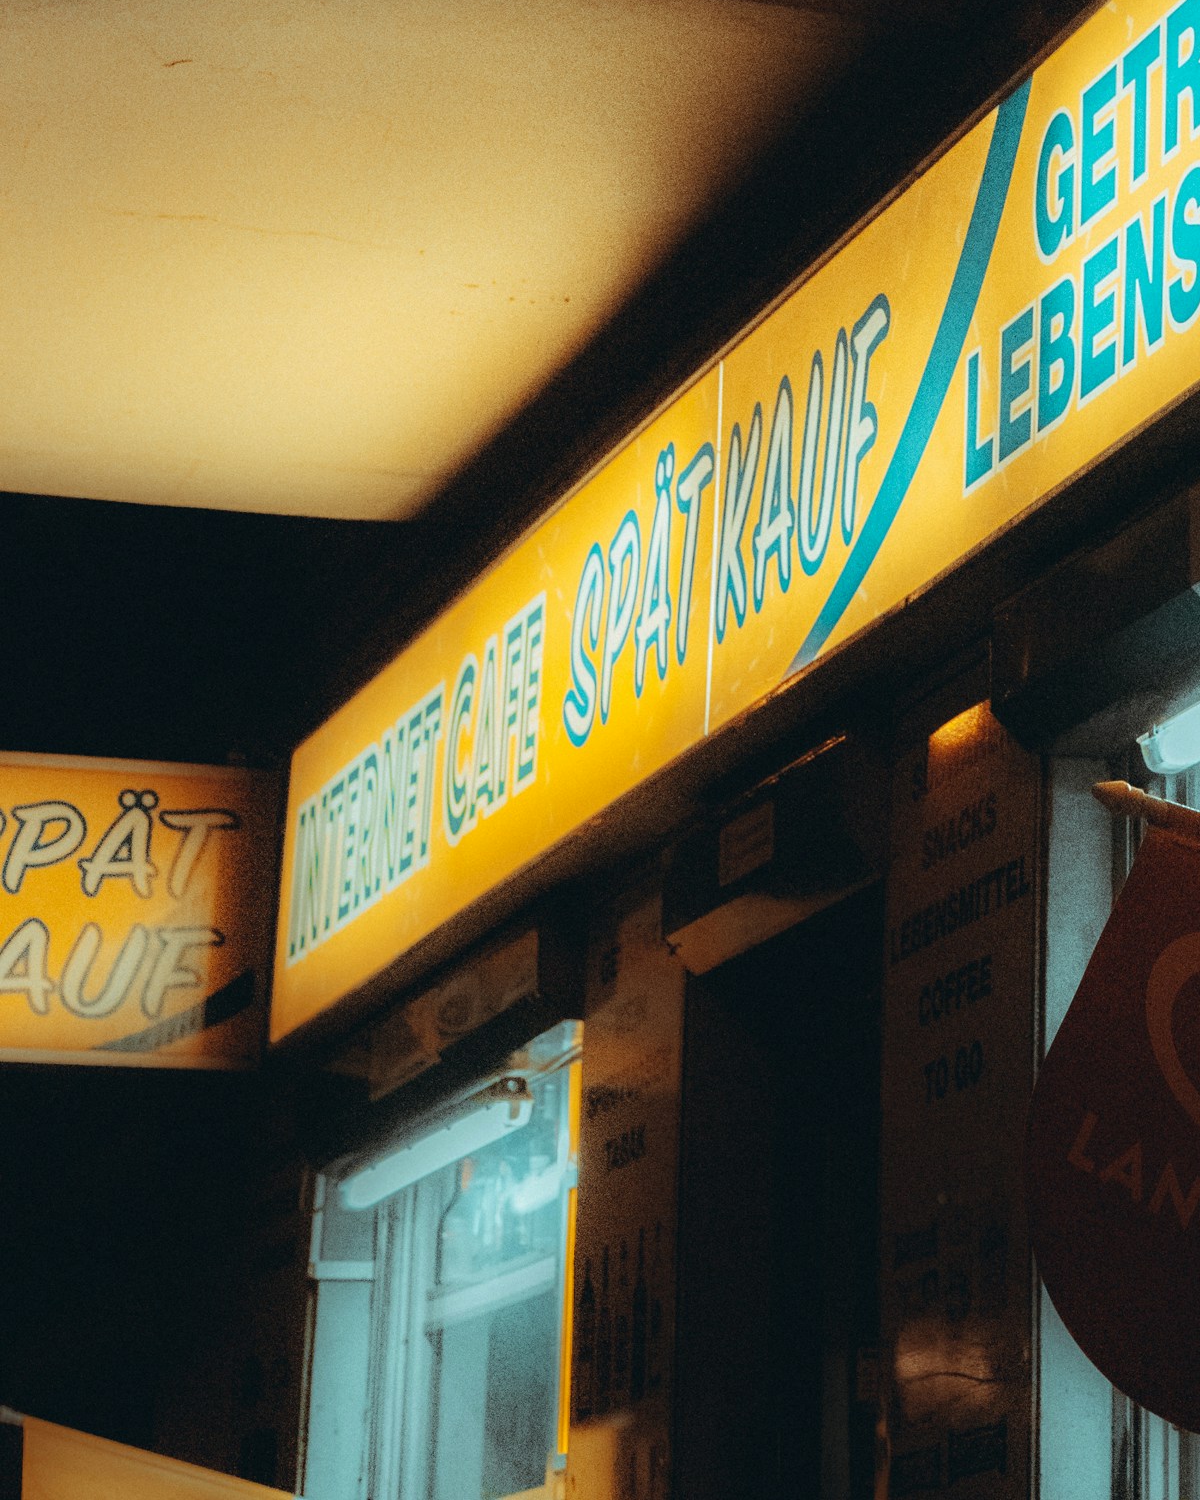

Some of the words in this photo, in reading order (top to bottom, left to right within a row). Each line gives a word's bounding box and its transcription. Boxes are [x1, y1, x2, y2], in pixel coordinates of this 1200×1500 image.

[287, 682, 446, 967] INTERNET
[443, 591, 547, 846] CAFE
[0, 789, 241, 900] PÄT
[921, 792, 998, 871] SNACKS
[889, 855, 1030, 966] LEBENSMITTEL
[919, 954, 993, 1026] COFFEE
[923, 1057, 948, 1105] TO
[954, 1039, 984, 1092] GO
